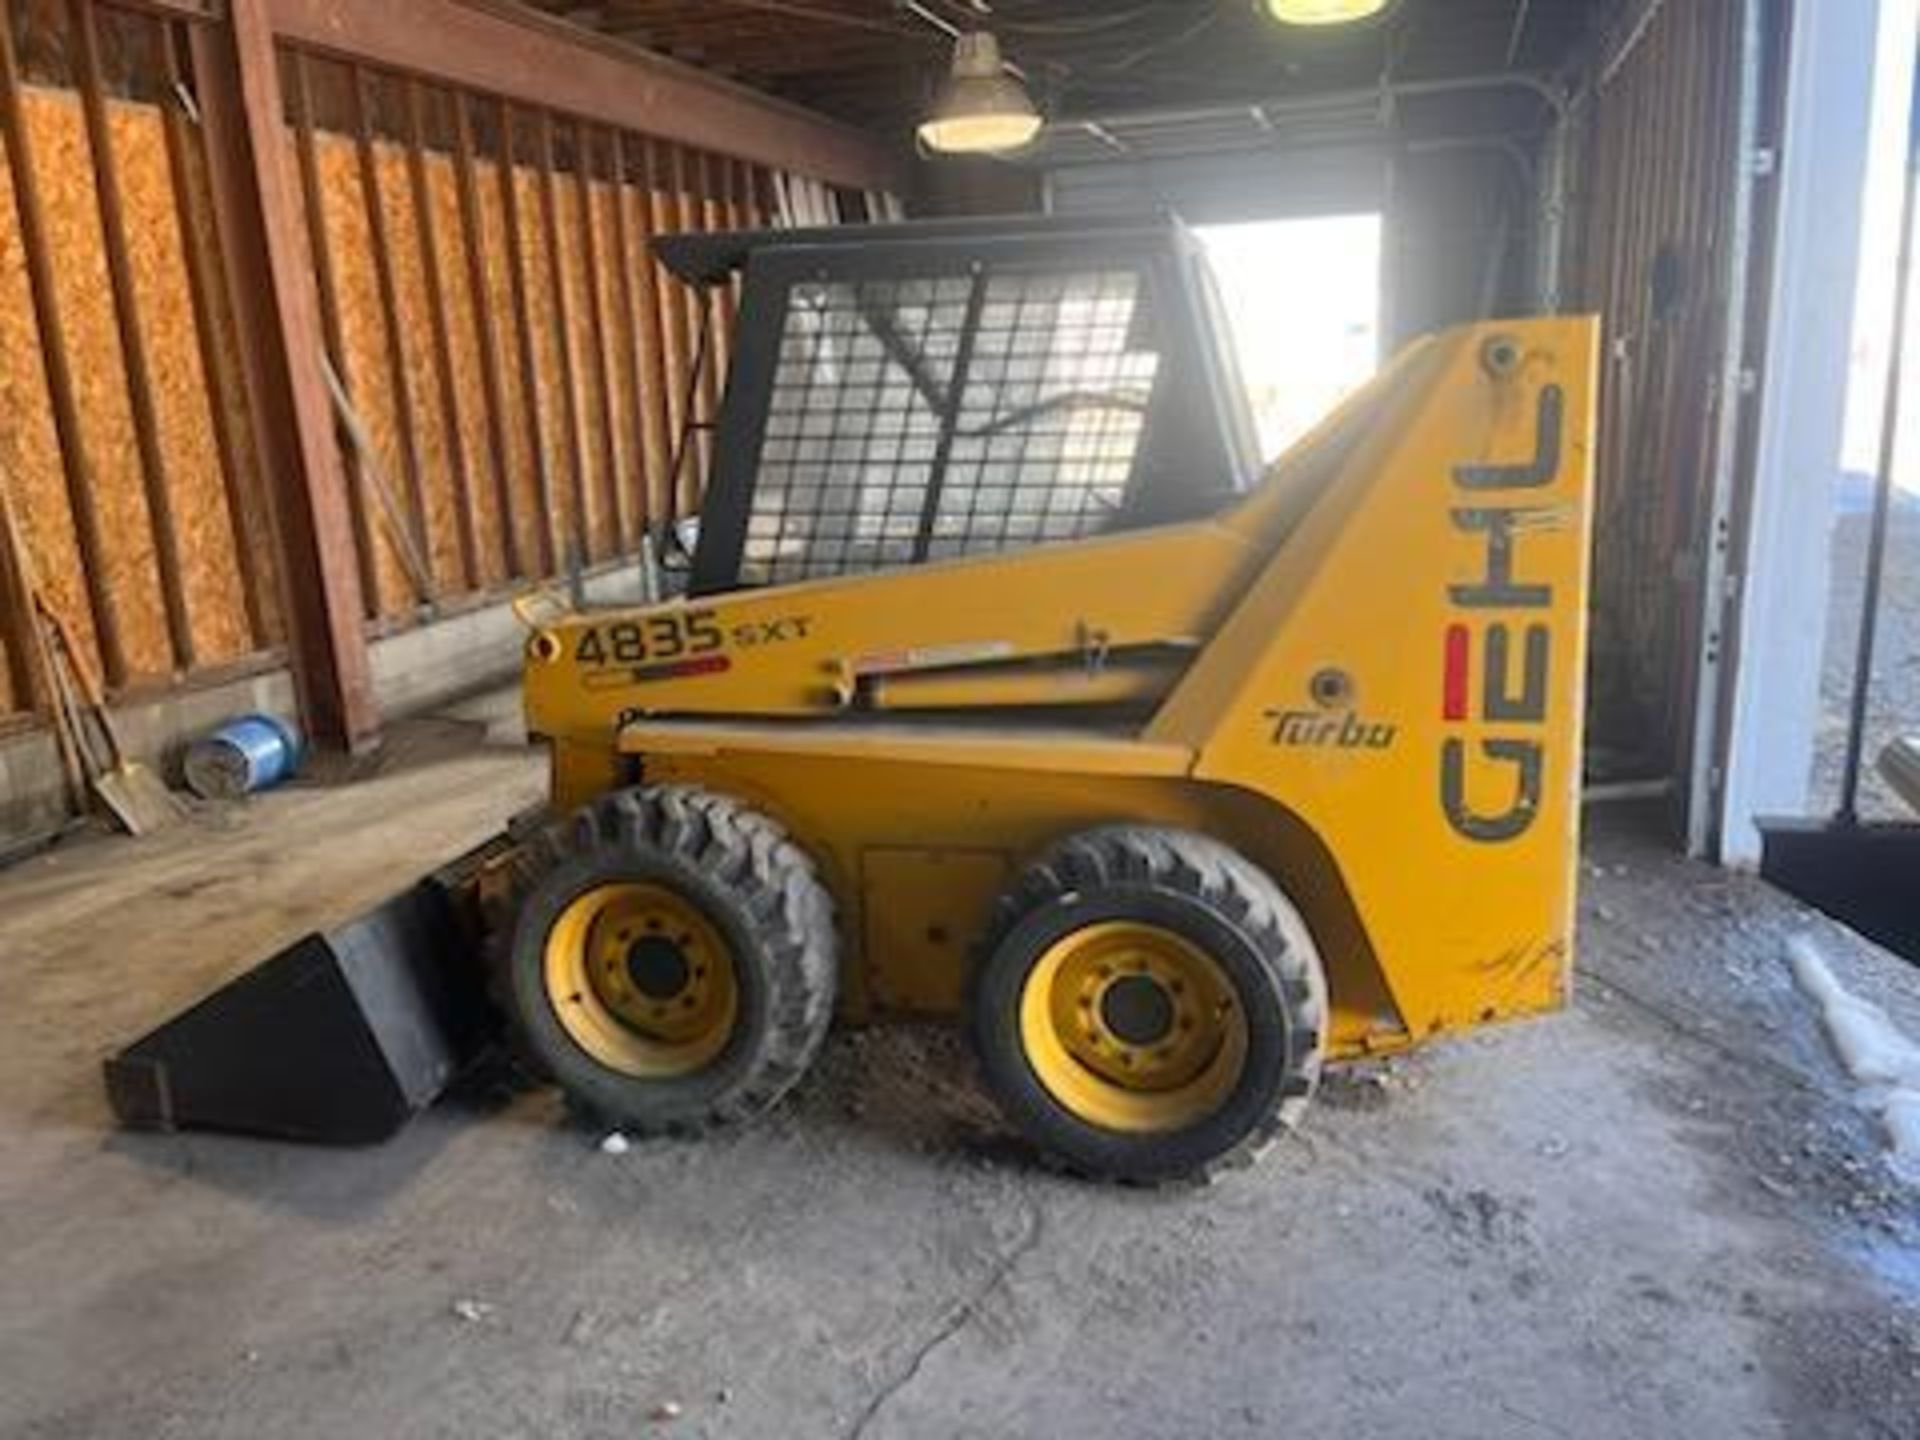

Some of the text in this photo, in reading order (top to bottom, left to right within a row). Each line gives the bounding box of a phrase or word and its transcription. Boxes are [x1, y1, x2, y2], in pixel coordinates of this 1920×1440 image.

[576, 611, 813, 666] 4835 SXT
[1440, 382, 1564, 843] GEHL
[1263, 708, 1398, 750] Turbo
